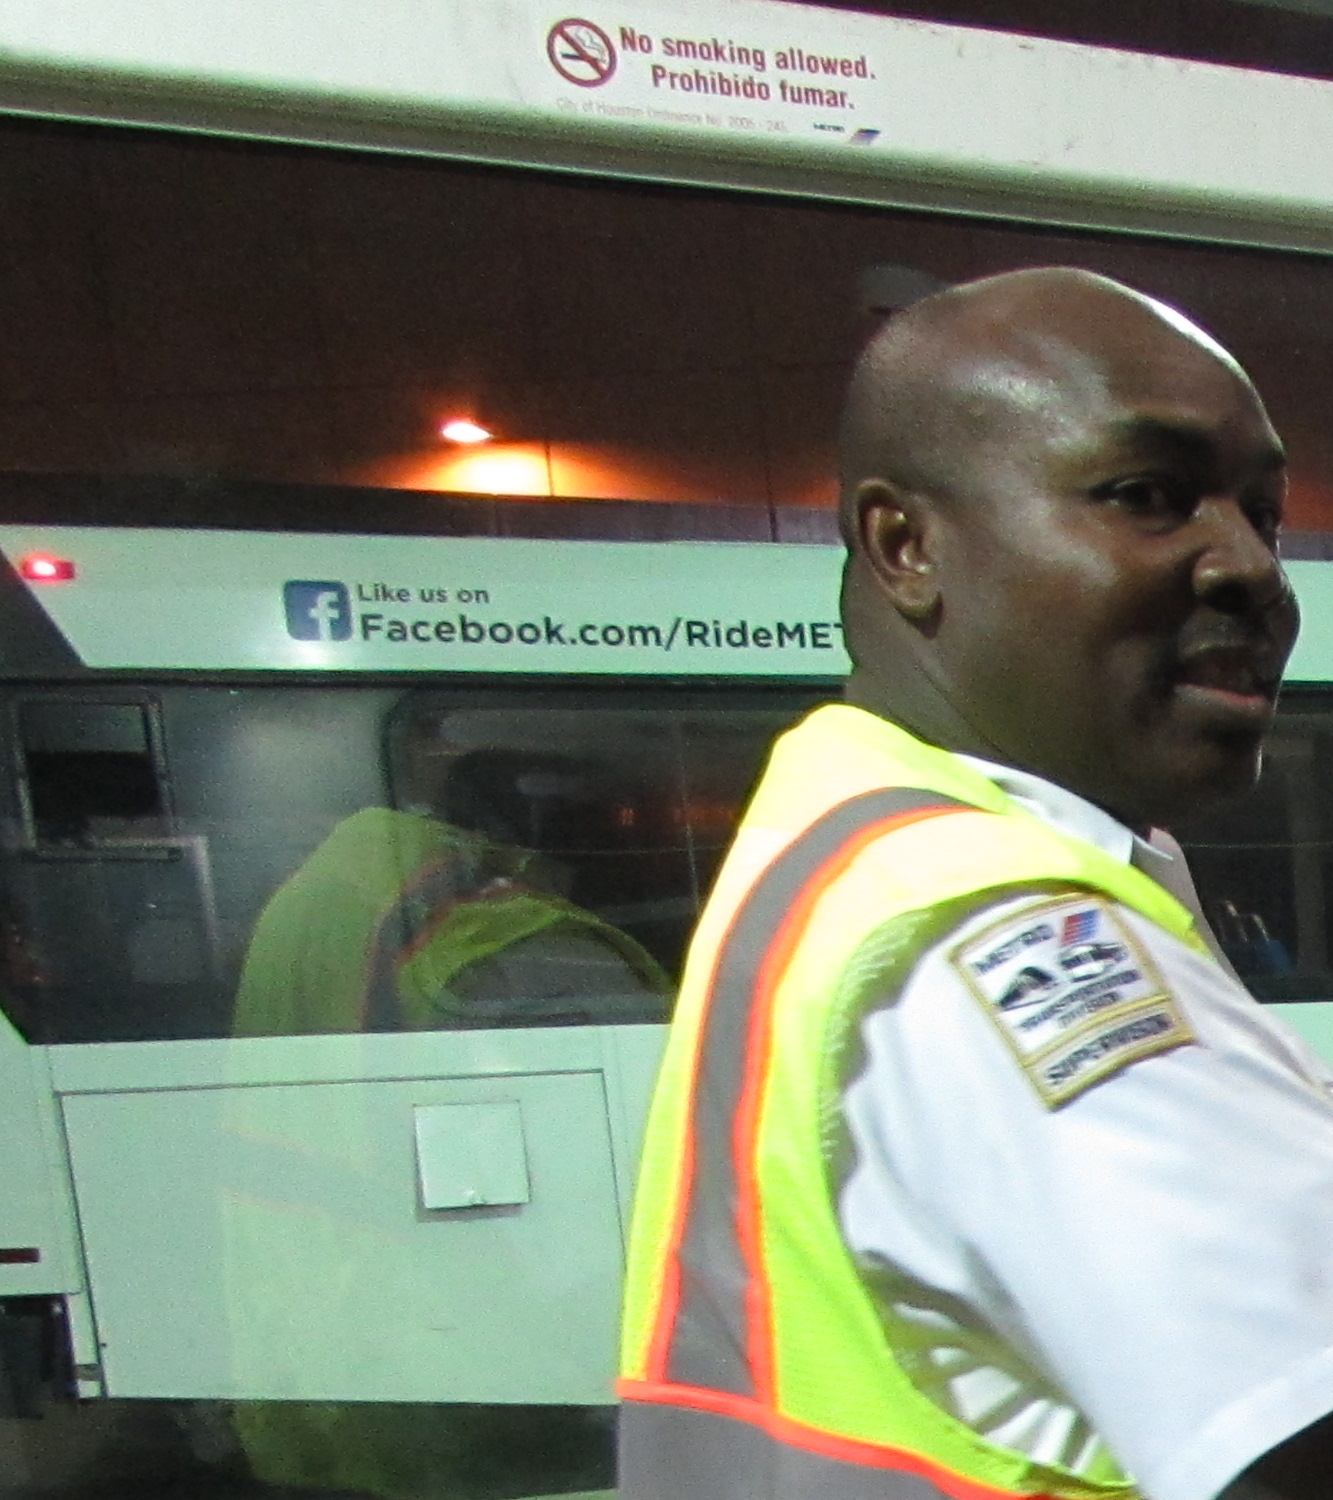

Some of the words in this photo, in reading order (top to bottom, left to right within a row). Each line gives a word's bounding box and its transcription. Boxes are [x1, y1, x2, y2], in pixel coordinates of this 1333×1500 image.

[619, 25, 653, 55] No
[662, 37, 767, 72] smoking
[775, 49, 878, 80] allowed.
[651, 64, 771, 101] Prohibido
[779, 81, 856, 111] fumar.
[356, 583, 411, 604] Like
[418, 588, 449, 605] us
[456, 588, 491, 606] on
[359, 611, 845, 652] Facebook.com/RideME
